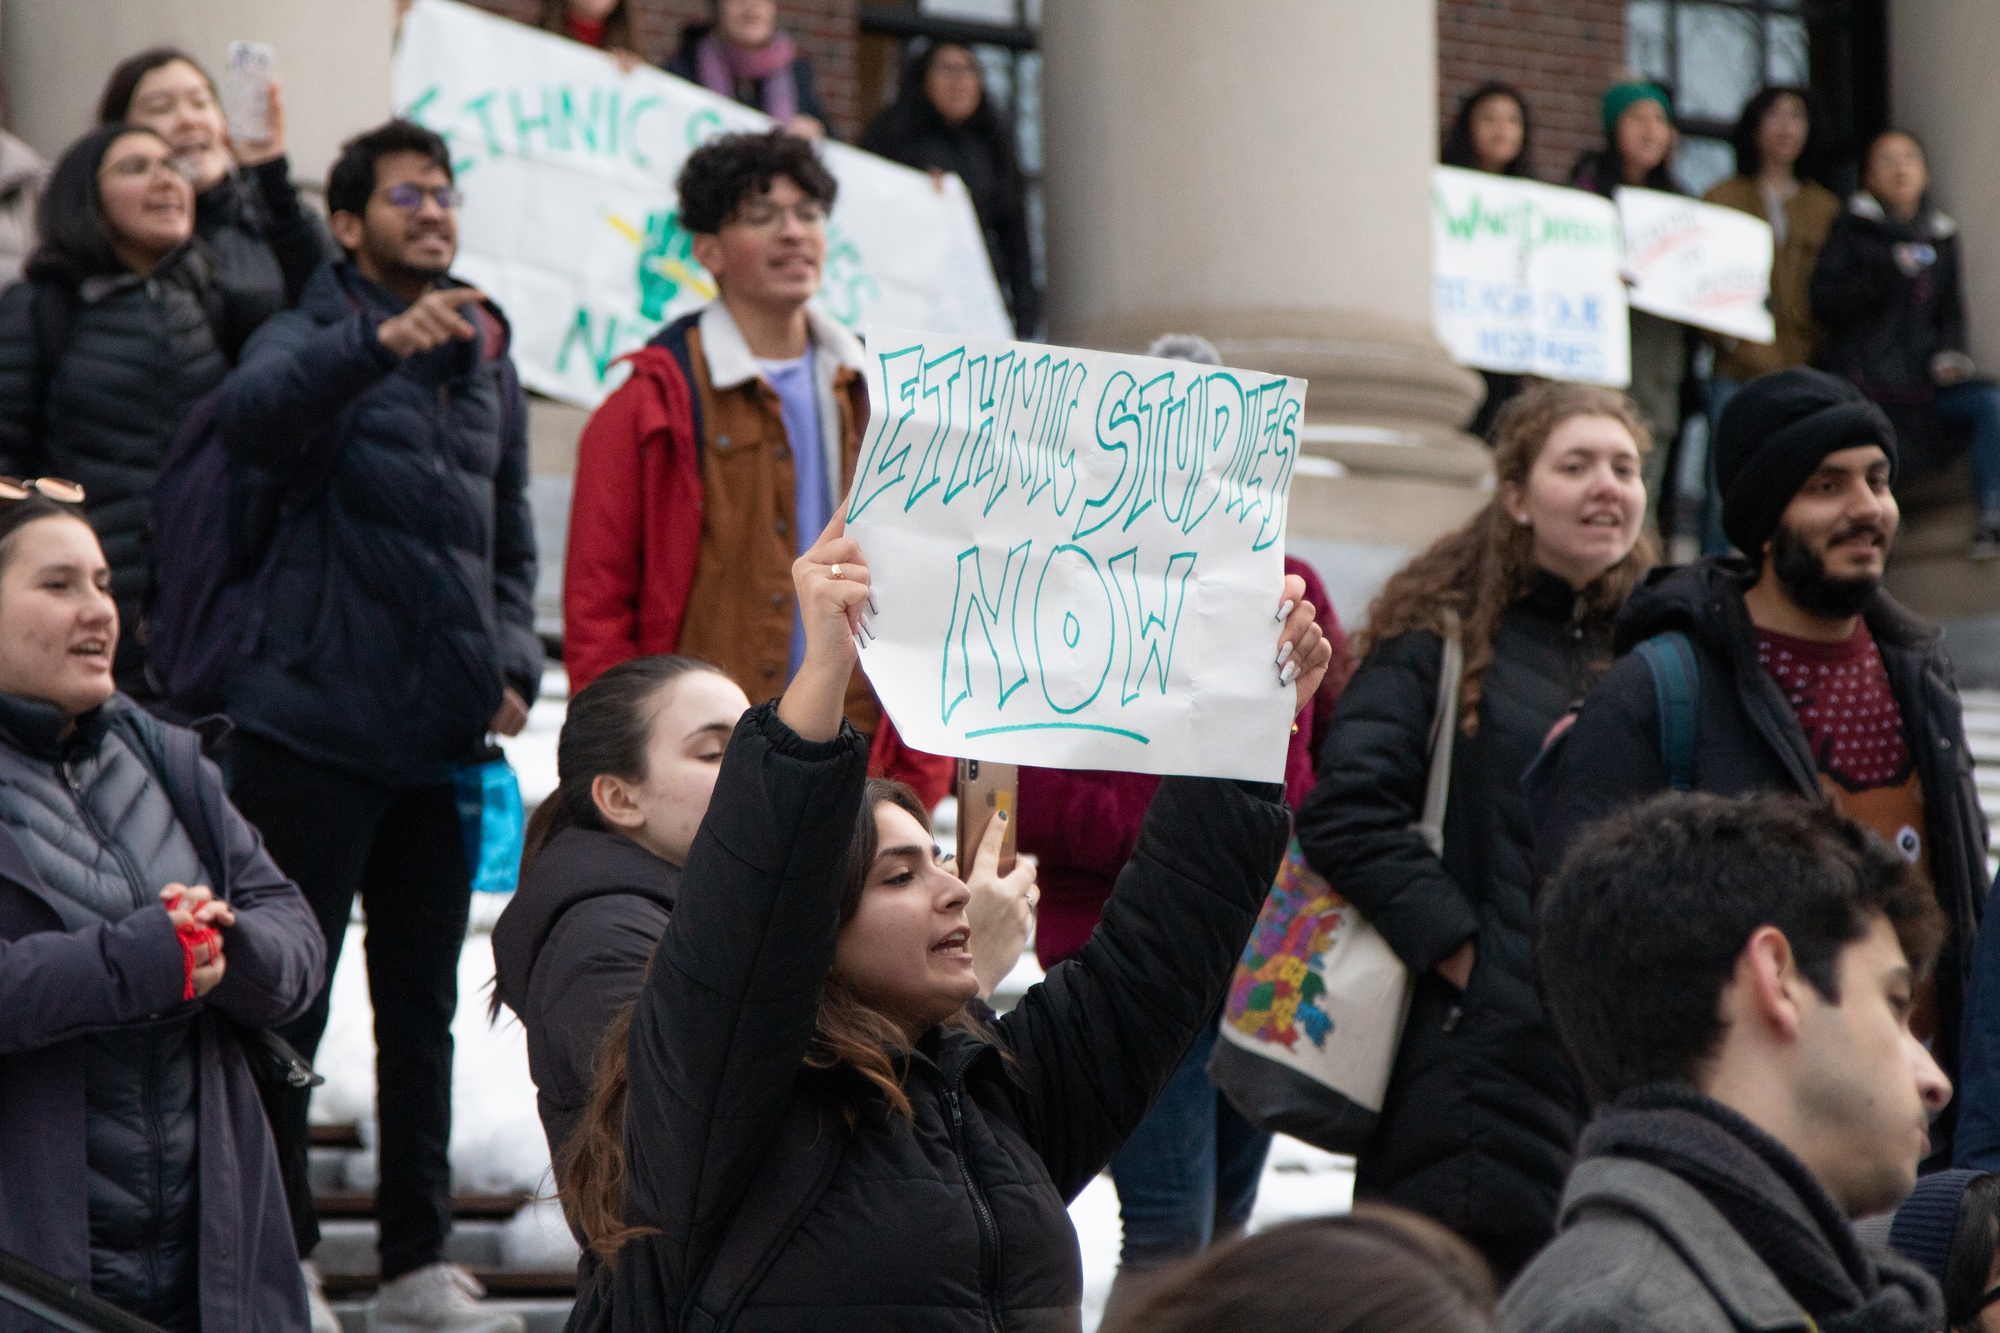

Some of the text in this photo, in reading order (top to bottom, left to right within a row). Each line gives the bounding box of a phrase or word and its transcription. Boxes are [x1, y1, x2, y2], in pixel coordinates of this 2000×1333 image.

[406, 83, 662, 175] ETHNIC
[846, 344, 1088, 524] ETHNIC
[1072, 370, 1301, 552] STUDIES
[942, 539, 1198, 727] NOW
